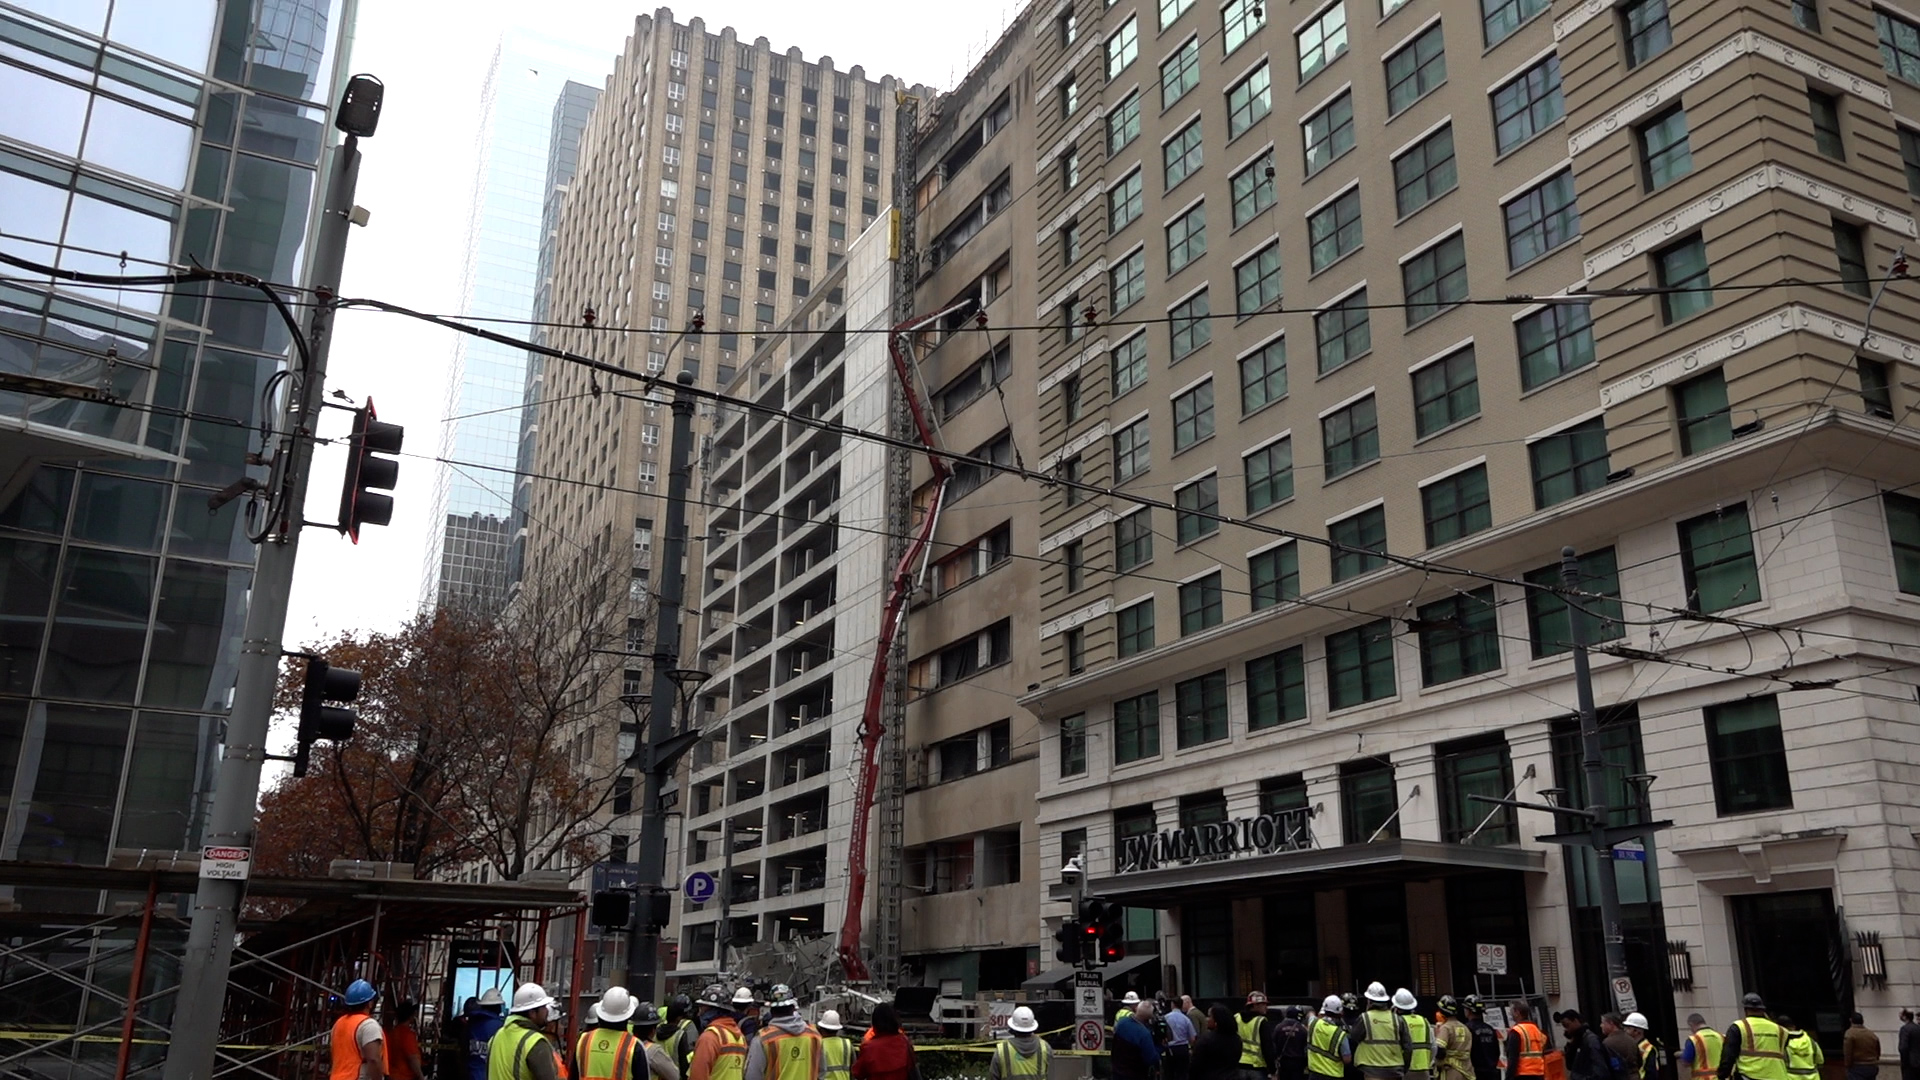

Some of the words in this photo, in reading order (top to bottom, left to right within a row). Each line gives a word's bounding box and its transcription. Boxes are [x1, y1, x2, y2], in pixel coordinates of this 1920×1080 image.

[1118, 834, 1159, 871] JW
[1160, 807, 1314, 861] MARRIOTT
[209, 849, 244, 859] DANGER
[206, 869, 242, 877] VOLTAGE
[693, 878, 707, 896] P
